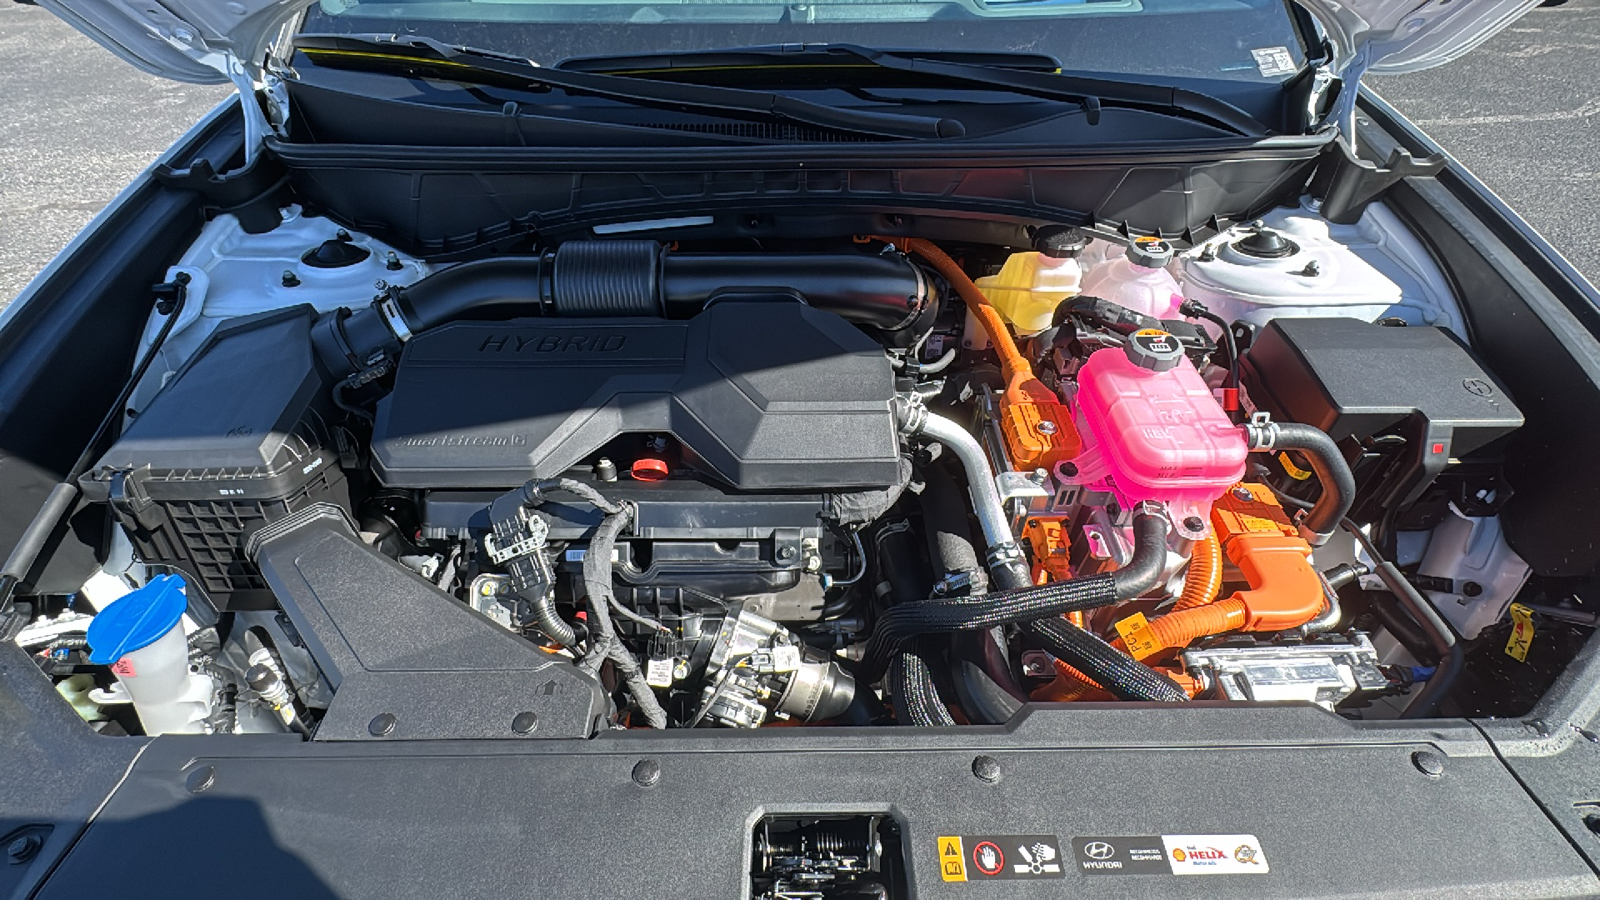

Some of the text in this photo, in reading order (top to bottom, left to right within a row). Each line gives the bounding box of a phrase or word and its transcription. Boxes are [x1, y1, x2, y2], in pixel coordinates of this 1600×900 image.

[479, 334, 628, 352] HYBRID
[1188, 847, 1227, 859] HELIX
[1083, 861, 1123, 869] HYUNDAI
